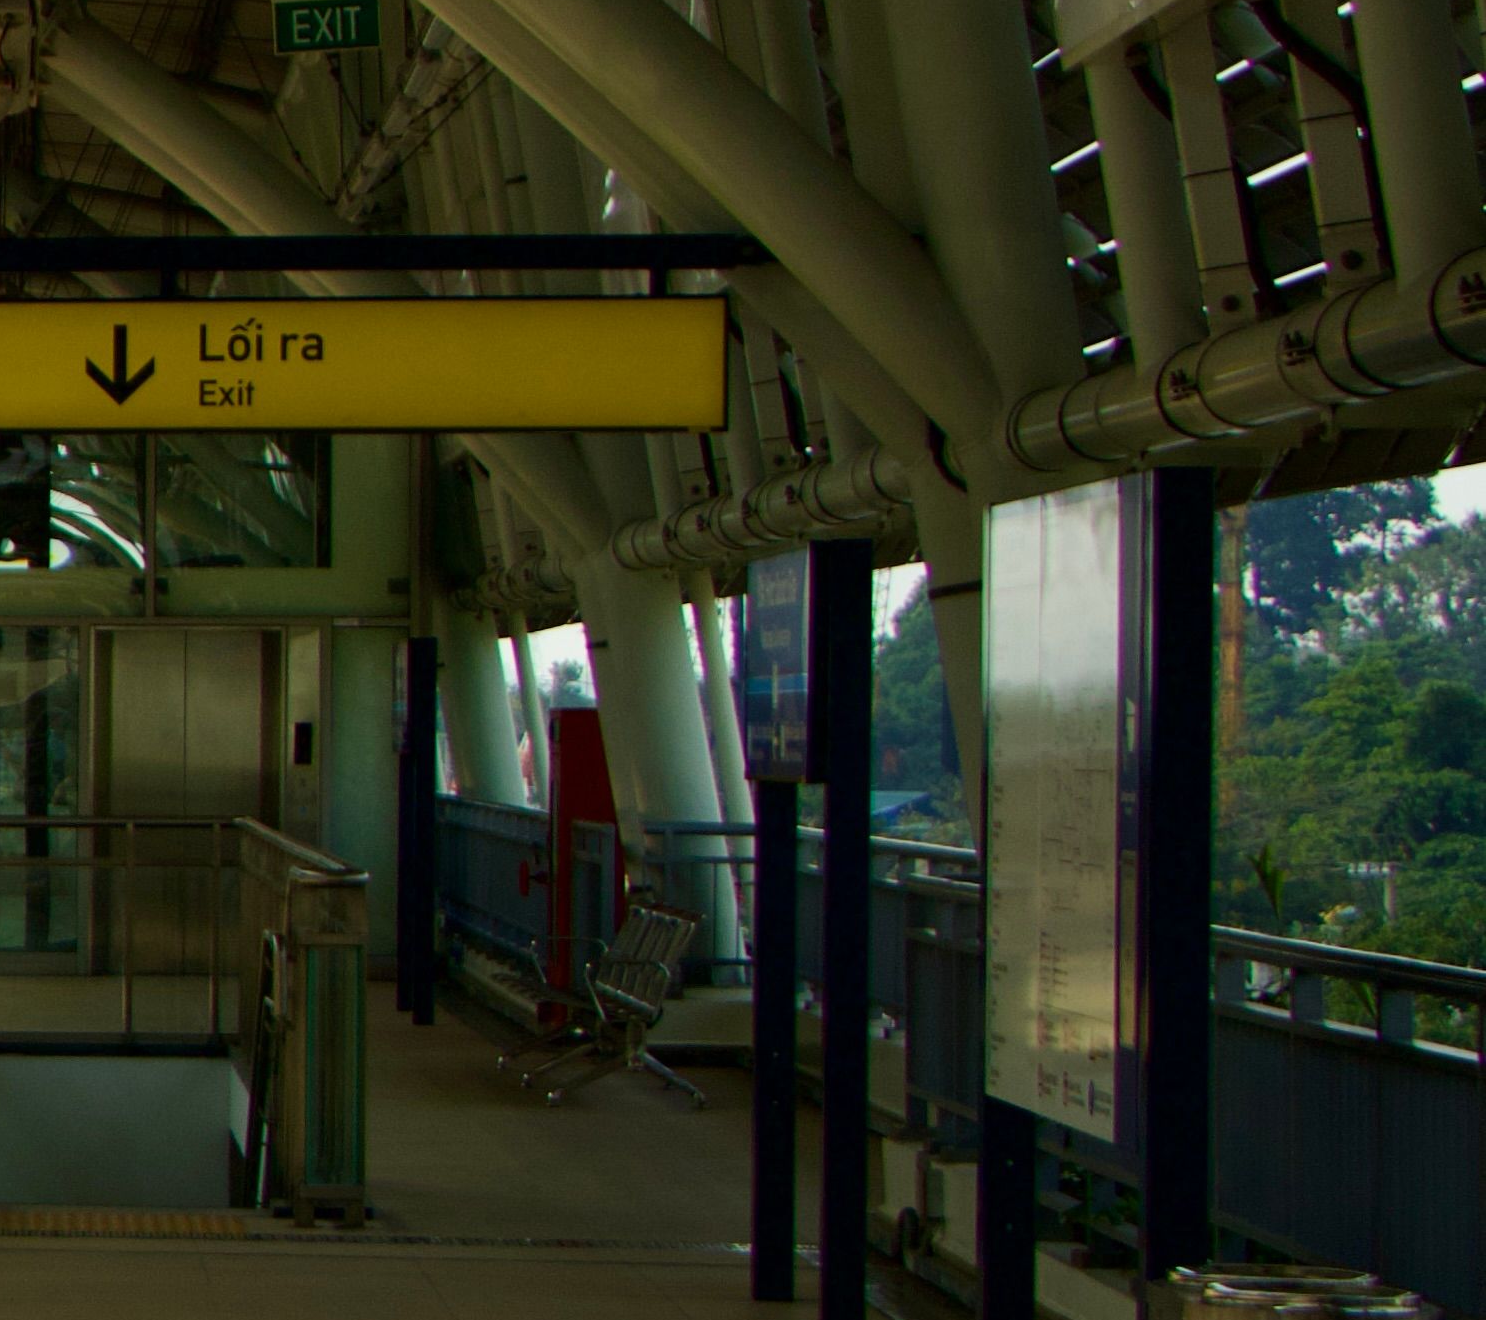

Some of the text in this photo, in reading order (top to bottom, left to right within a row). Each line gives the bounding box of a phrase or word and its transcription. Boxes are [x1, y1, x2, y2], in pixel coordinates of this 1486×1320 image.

[291, 4, 362, 44] EXIT
[199, 317, 323, 361] Lối ra
[199, 379, 256, 406] Exit
